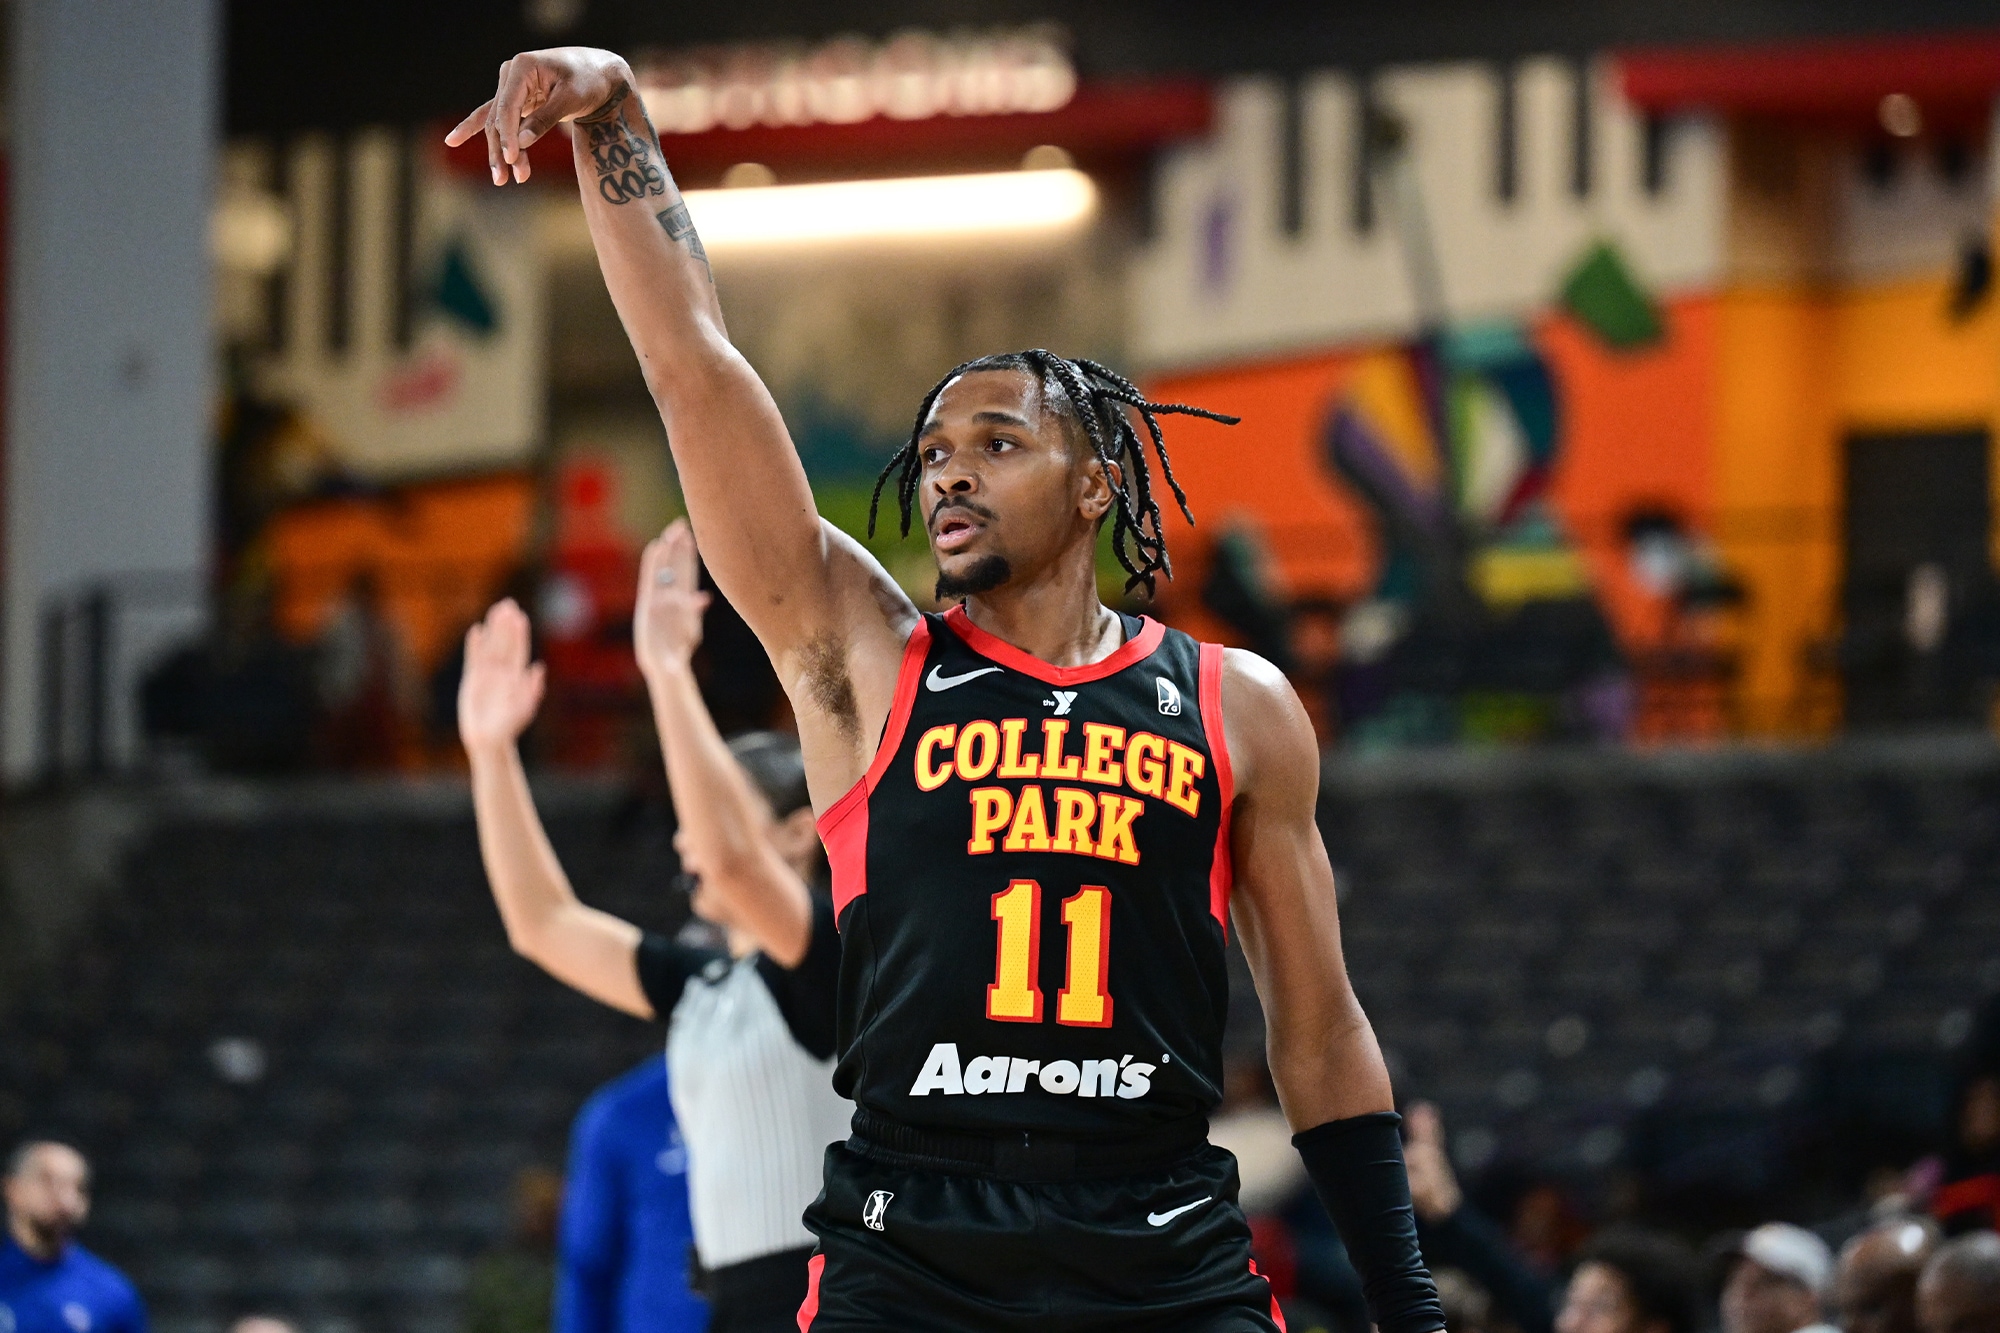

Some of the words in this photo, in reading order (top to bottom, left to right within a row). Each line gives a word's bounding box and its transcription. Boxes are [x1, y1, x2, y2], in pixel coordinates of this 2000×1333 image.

[1052, 691, 1078, 715] Y
[914, 718, 1204, 818] COLLEGE
[968, 785, 1145, 866] PARK
[986, 878, 1113, 1028] 11
[909, 1043, 1156, 1100] Aaron's
